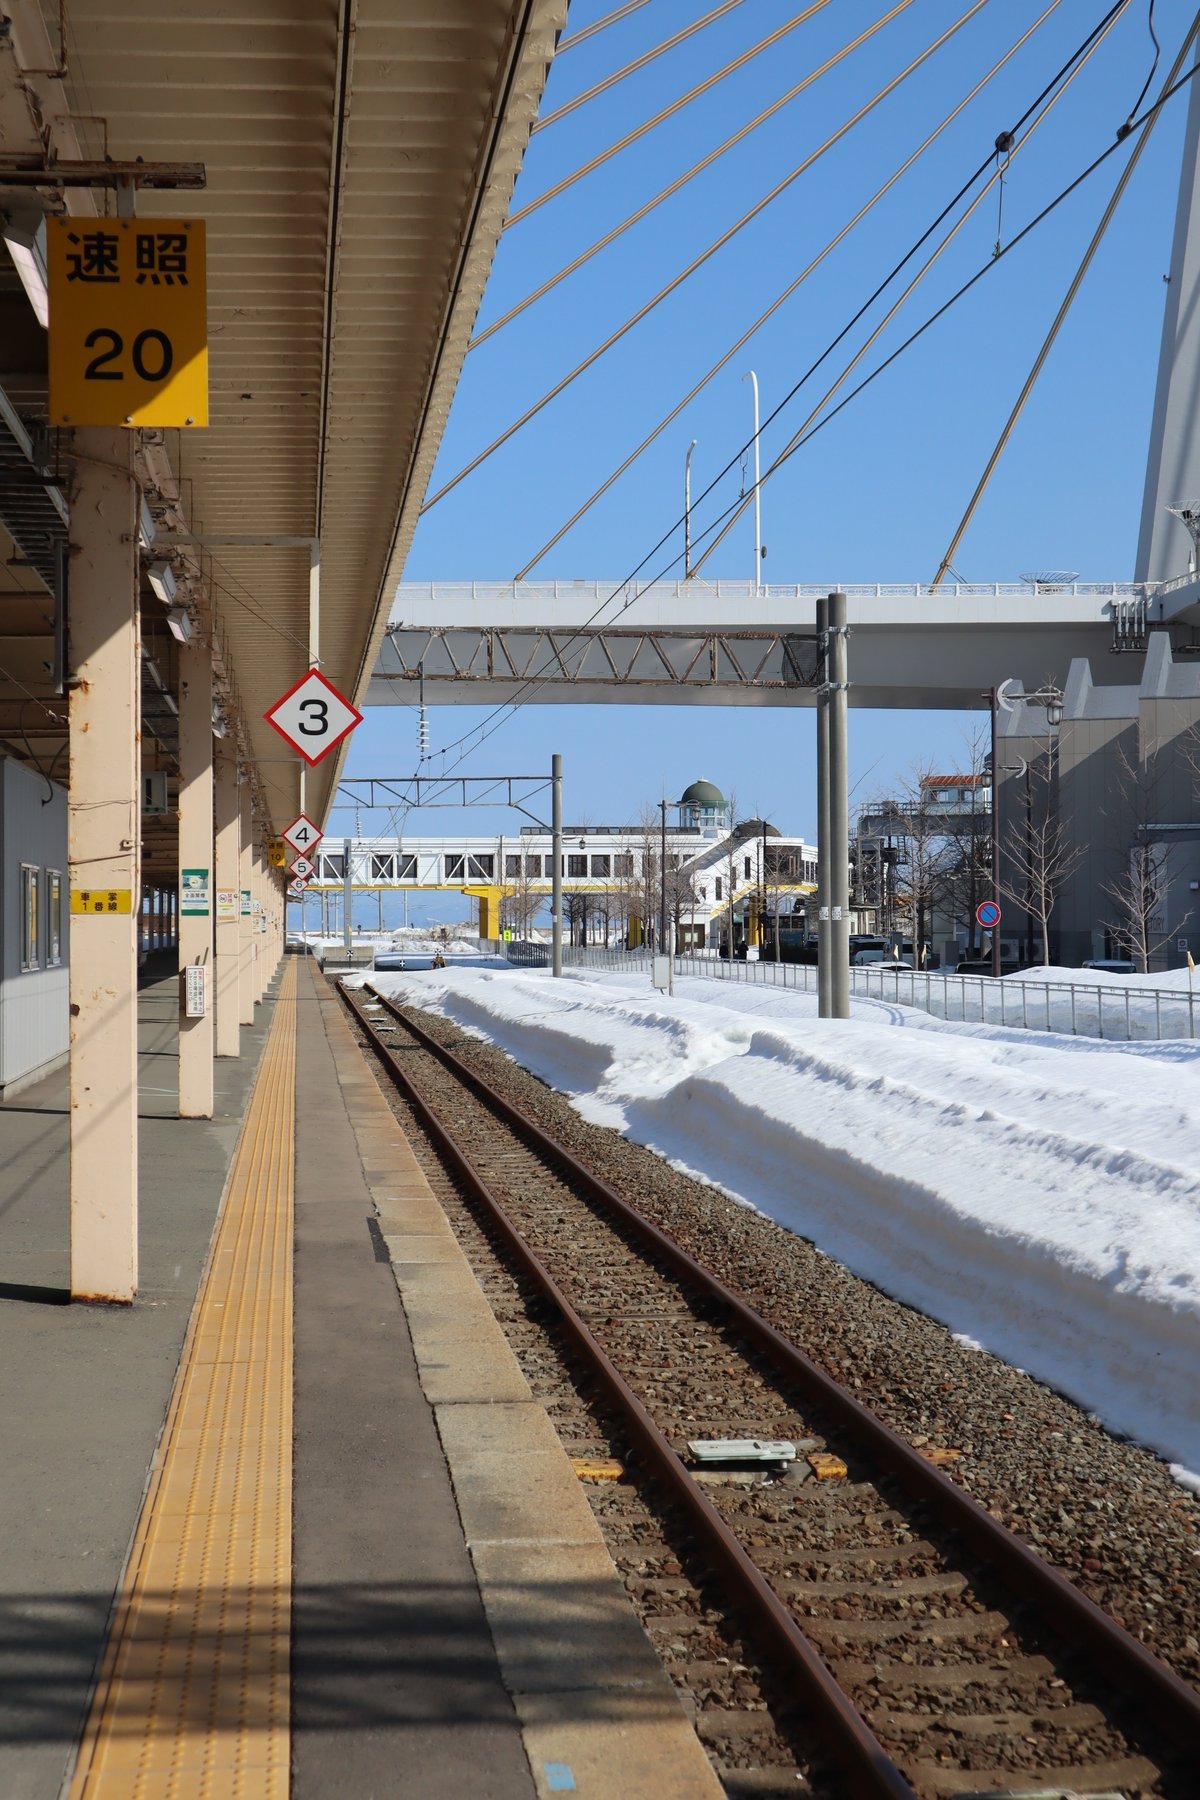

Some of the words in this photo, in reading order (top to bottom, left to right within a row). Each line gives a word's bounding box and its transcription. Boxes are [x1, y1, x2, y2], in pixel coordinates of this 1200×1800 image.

[66, 231, 188, 286] 速照
[84, 328, 173, 382] 20
[298, 699, 329, 736] 3
[295, 827, 309, 843] 4
[297, 862, 307, 873] 5
[295, 880, 303, 889] 6
[82, 902, 117, 912] 1番線
